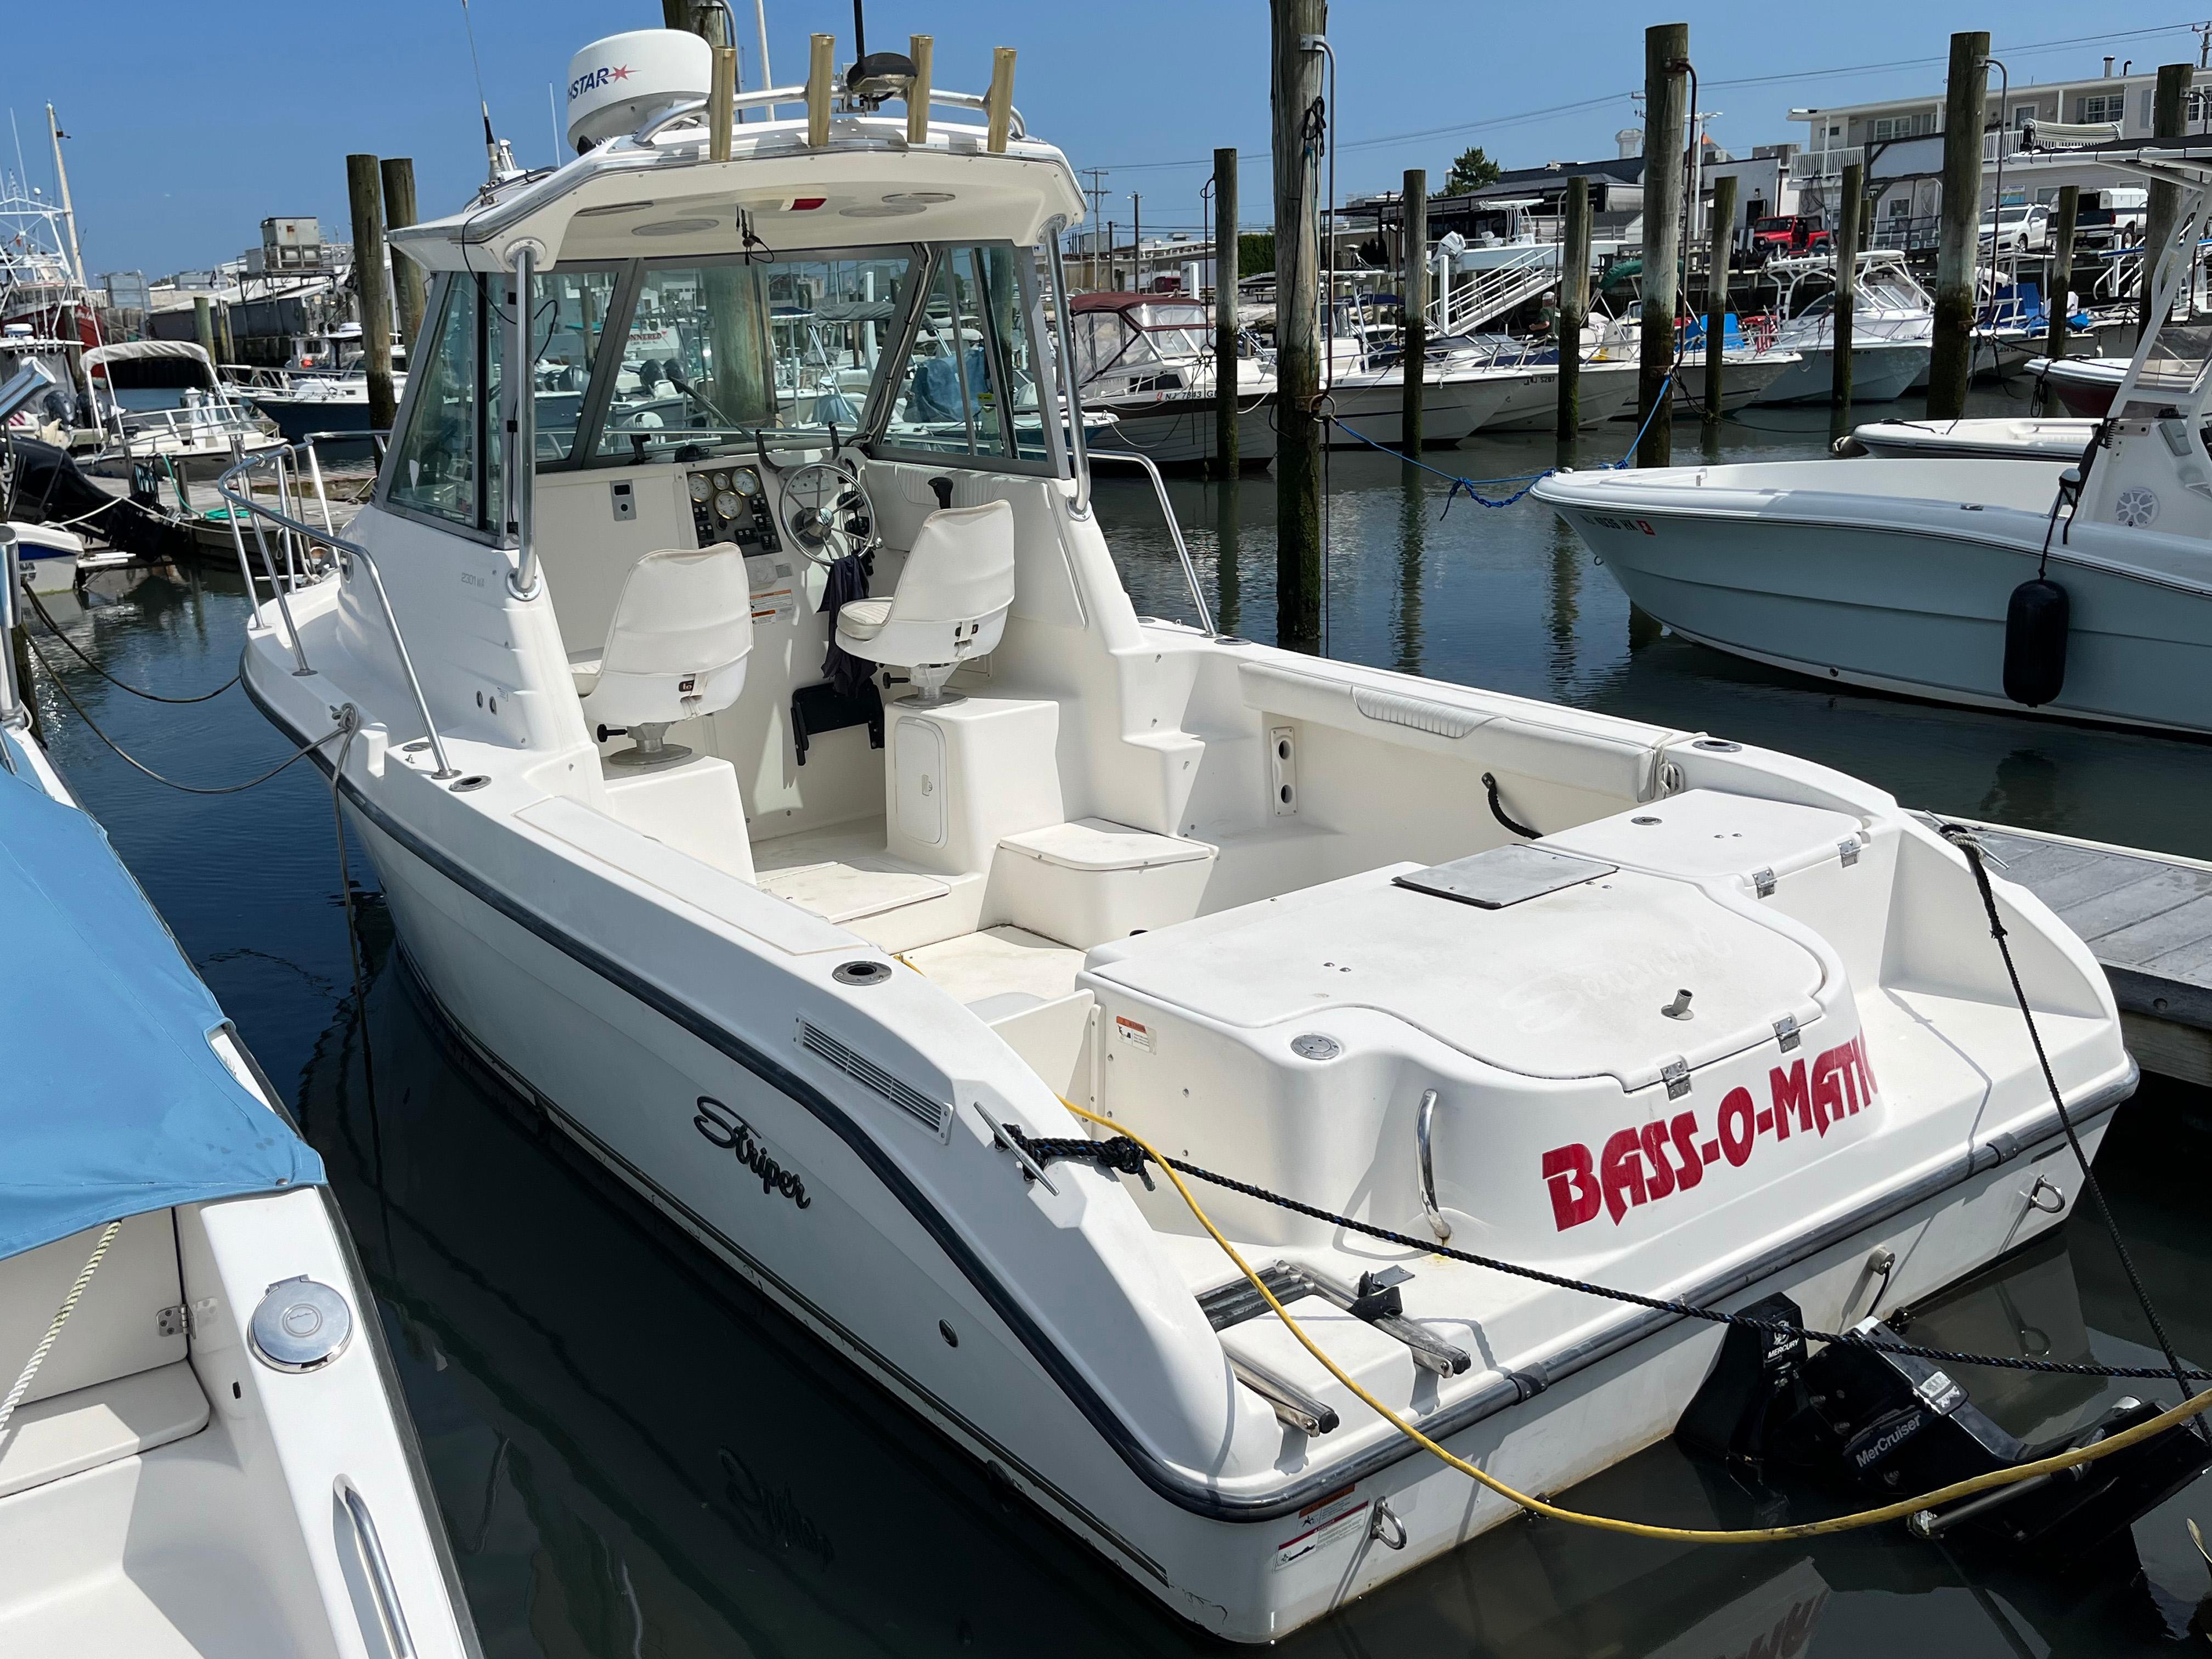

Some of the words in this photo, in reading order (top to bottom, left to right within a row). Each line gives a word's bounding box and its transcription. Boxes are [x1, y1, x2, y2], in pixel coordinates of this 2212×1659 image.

[693, 1096, 811, 1209] Striper
[1767, 1338, 1800, 1359] MERCURY
[1855, 1414, 1921, 1462] MerCruiser
